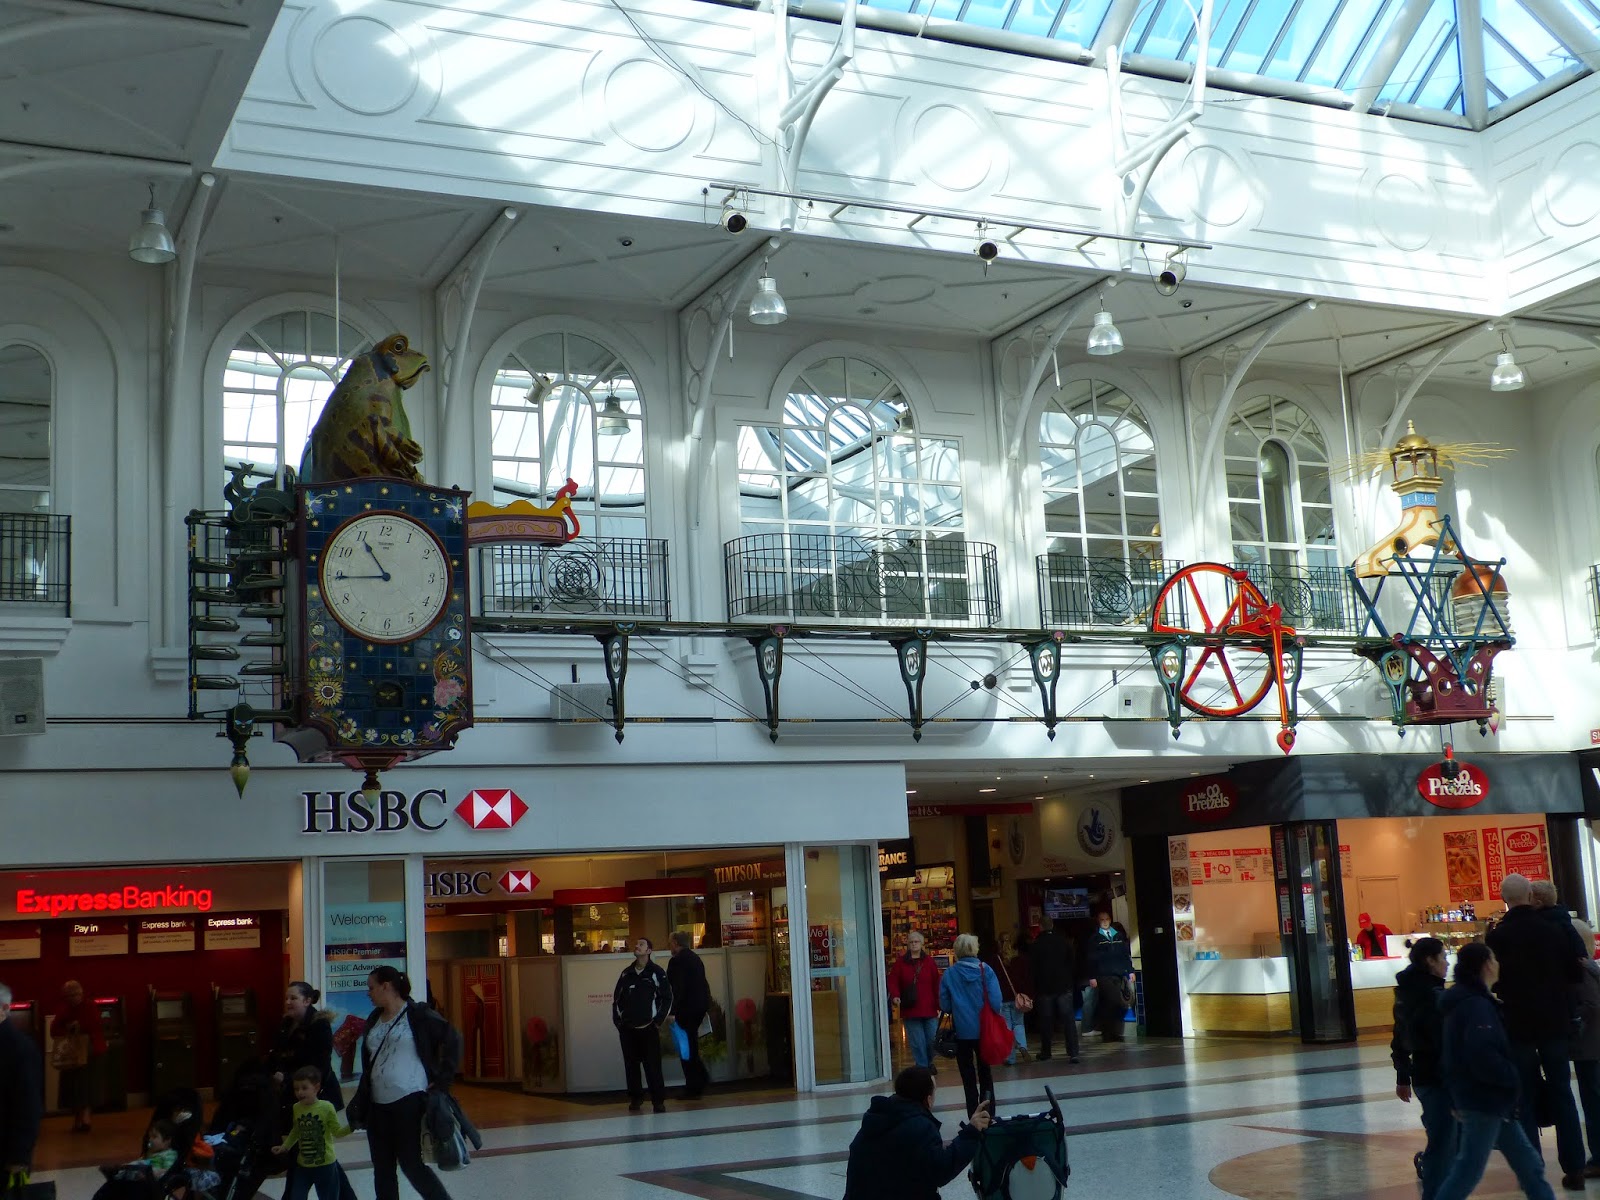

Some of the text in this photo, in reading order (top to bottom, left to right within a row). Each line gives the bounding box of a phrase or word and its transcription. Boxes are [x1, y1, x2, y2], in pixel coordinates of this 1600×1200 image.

[356, 531, 368, 542] 11
[379, 525, 392, 537] 12
[406, 533, 412, 544] 1
[338, 547, 353, 558] 10
[422, 549, 430, 560] 2
[428, 573, 435, 584] 3
[342, 593, 350, 604] 8
[422, 596, 430, 607] 4
[359, 611, 368, 622] 7
[407, 612, 415, 624] 5
[383, 618, 391, 630] 6
[1187, 793, 1230, 812] Pretzels
[302, 789, 448, 833] HSBC
[1509, 838, 1536, 848] Pretzels
[714, 863, 761, 883] TIMPSON
[141, 920, 187, 930] Express bank
[208, 917, 253, 928] Express bank
[330, 913, 387, 926] Welcome
[74, 924, 99, 934] Pay in
[330, 947, 382, 957] HSBC Premier
[331, 964, 352, 972] HSBC
[331, 980, 352, 988] HSBC
